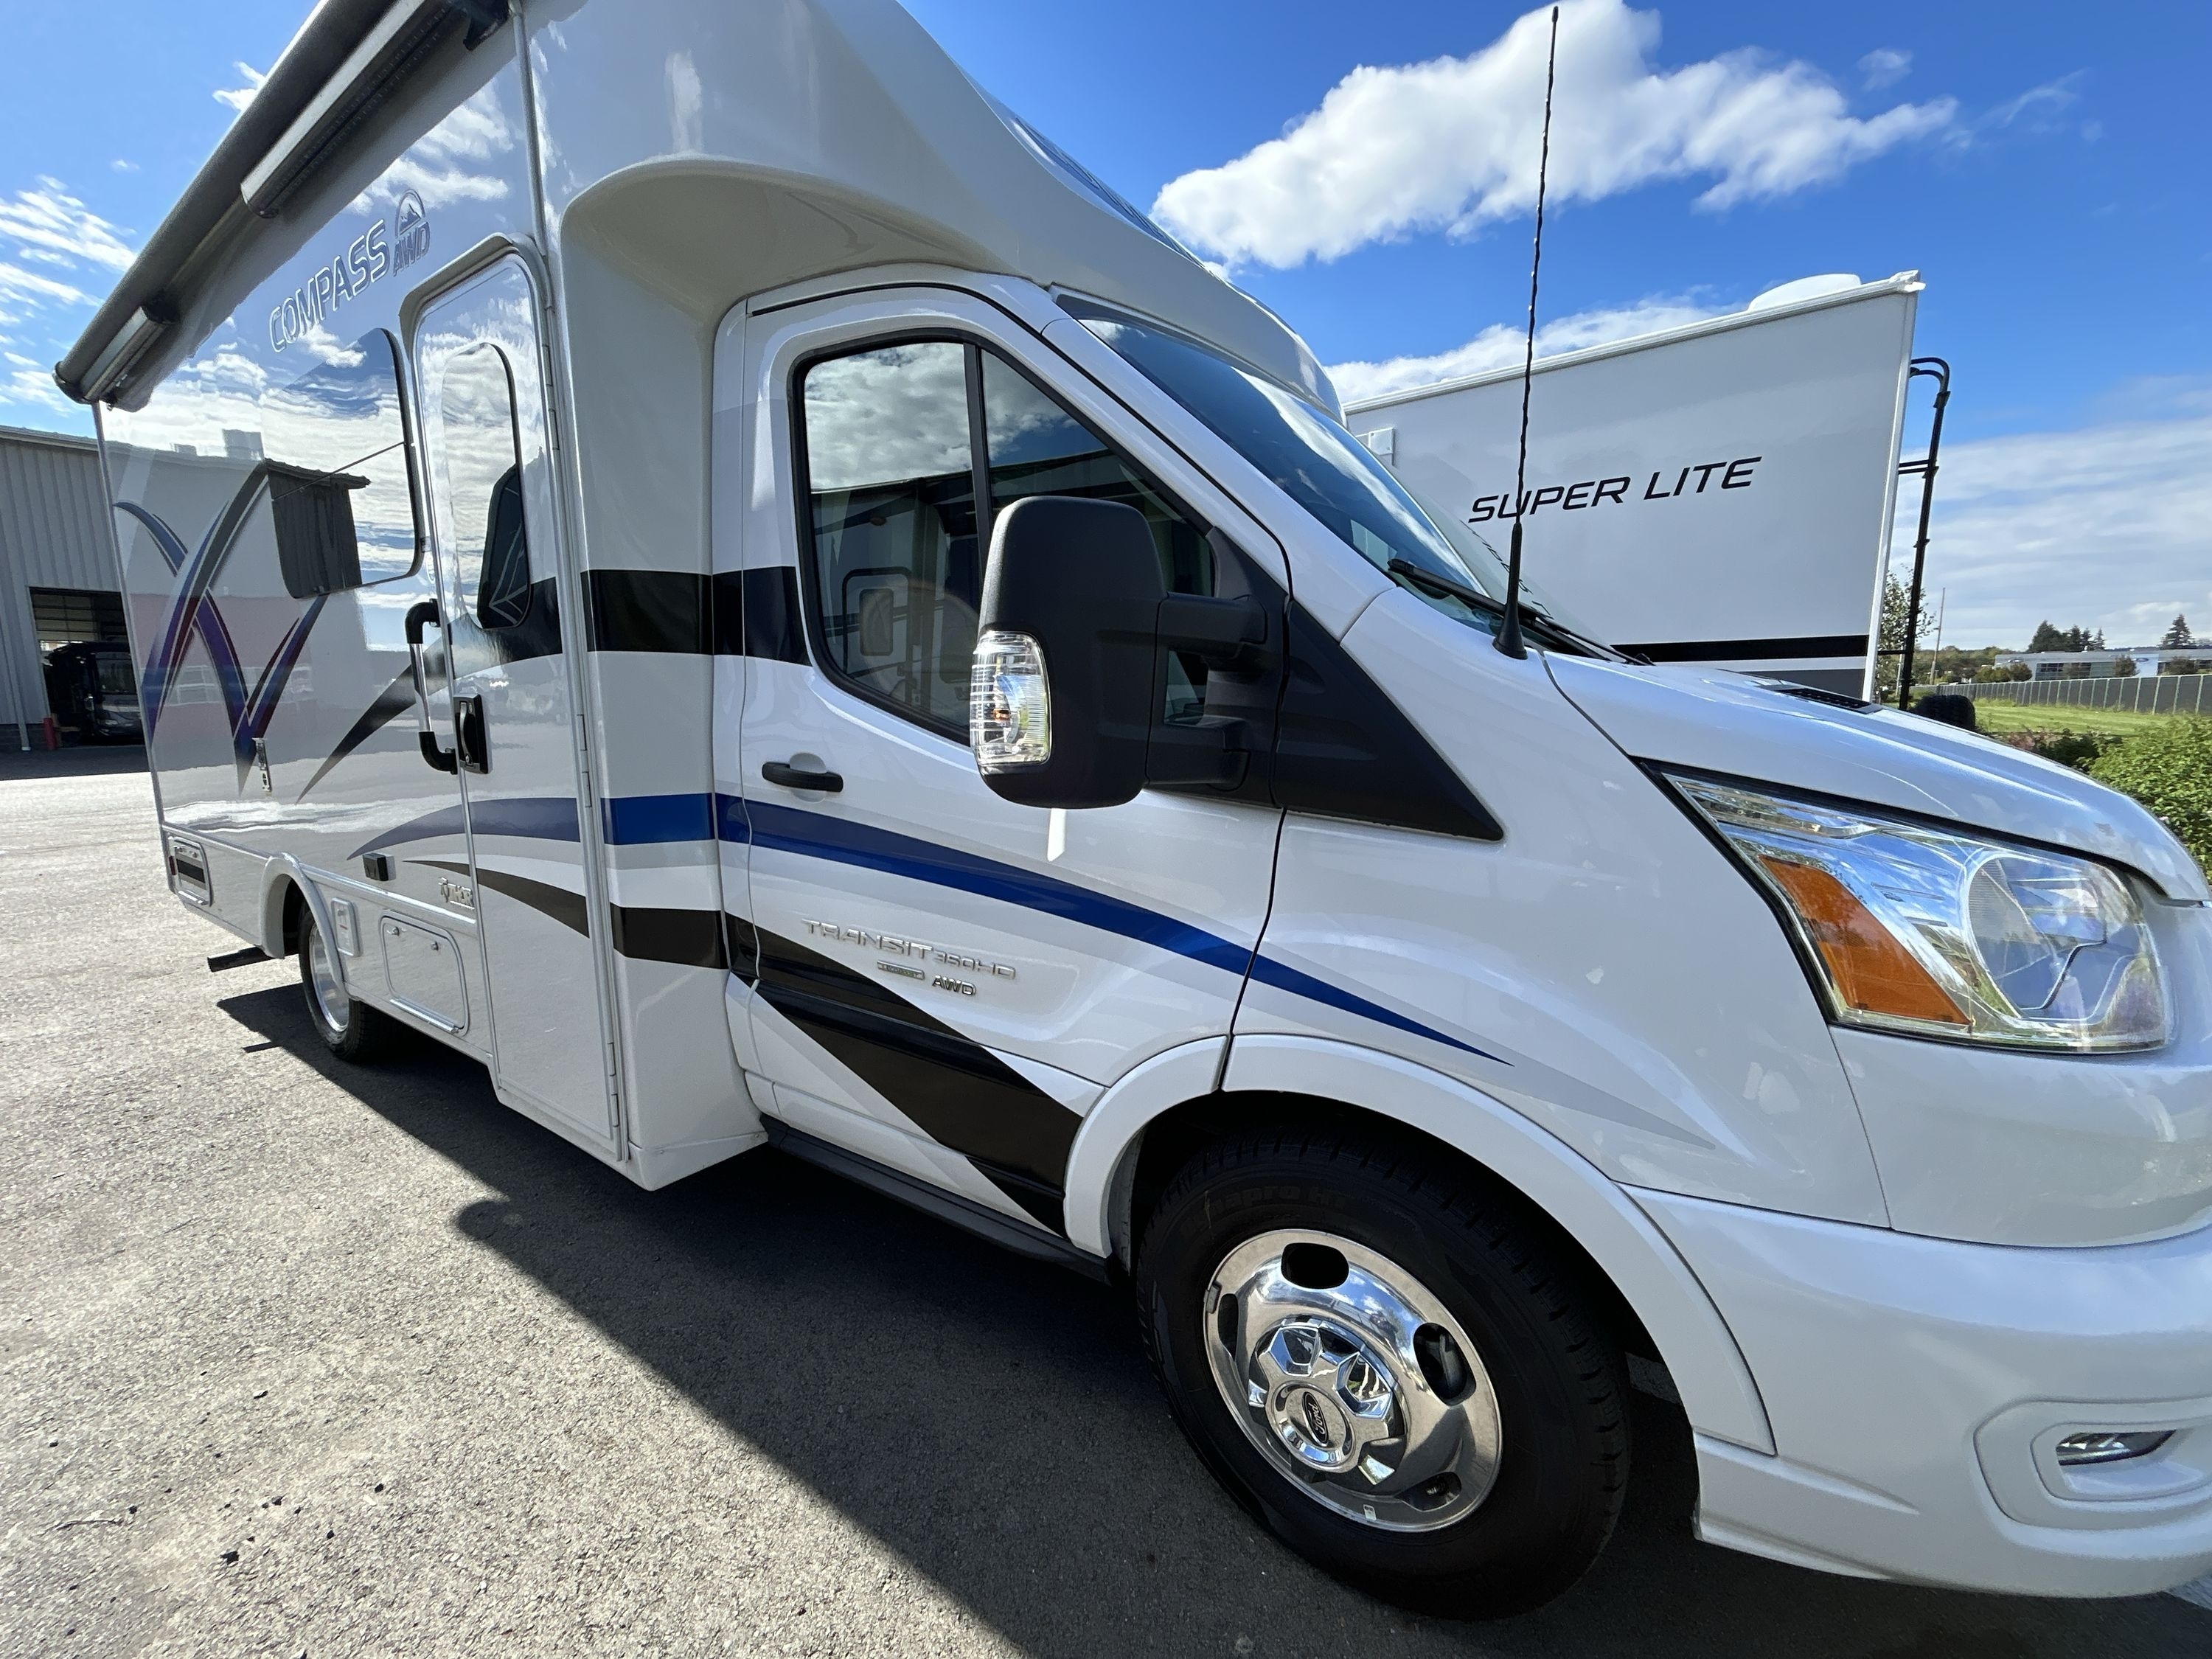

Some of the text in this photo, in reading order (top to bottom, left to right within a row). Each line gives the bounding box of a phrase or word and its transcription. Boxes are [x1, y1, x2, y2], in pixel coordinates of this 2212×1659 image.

[393, 221, 431, 277] AWD
[269, 219, 390, 353] COMPASS
[1468, 456, 1763, 524] SUPER LITE
[801, 918, 933, 959] TRANSIT
[932, 974, 977, 996] AWD
[1308, 1402, 1326, 1435] Ford
